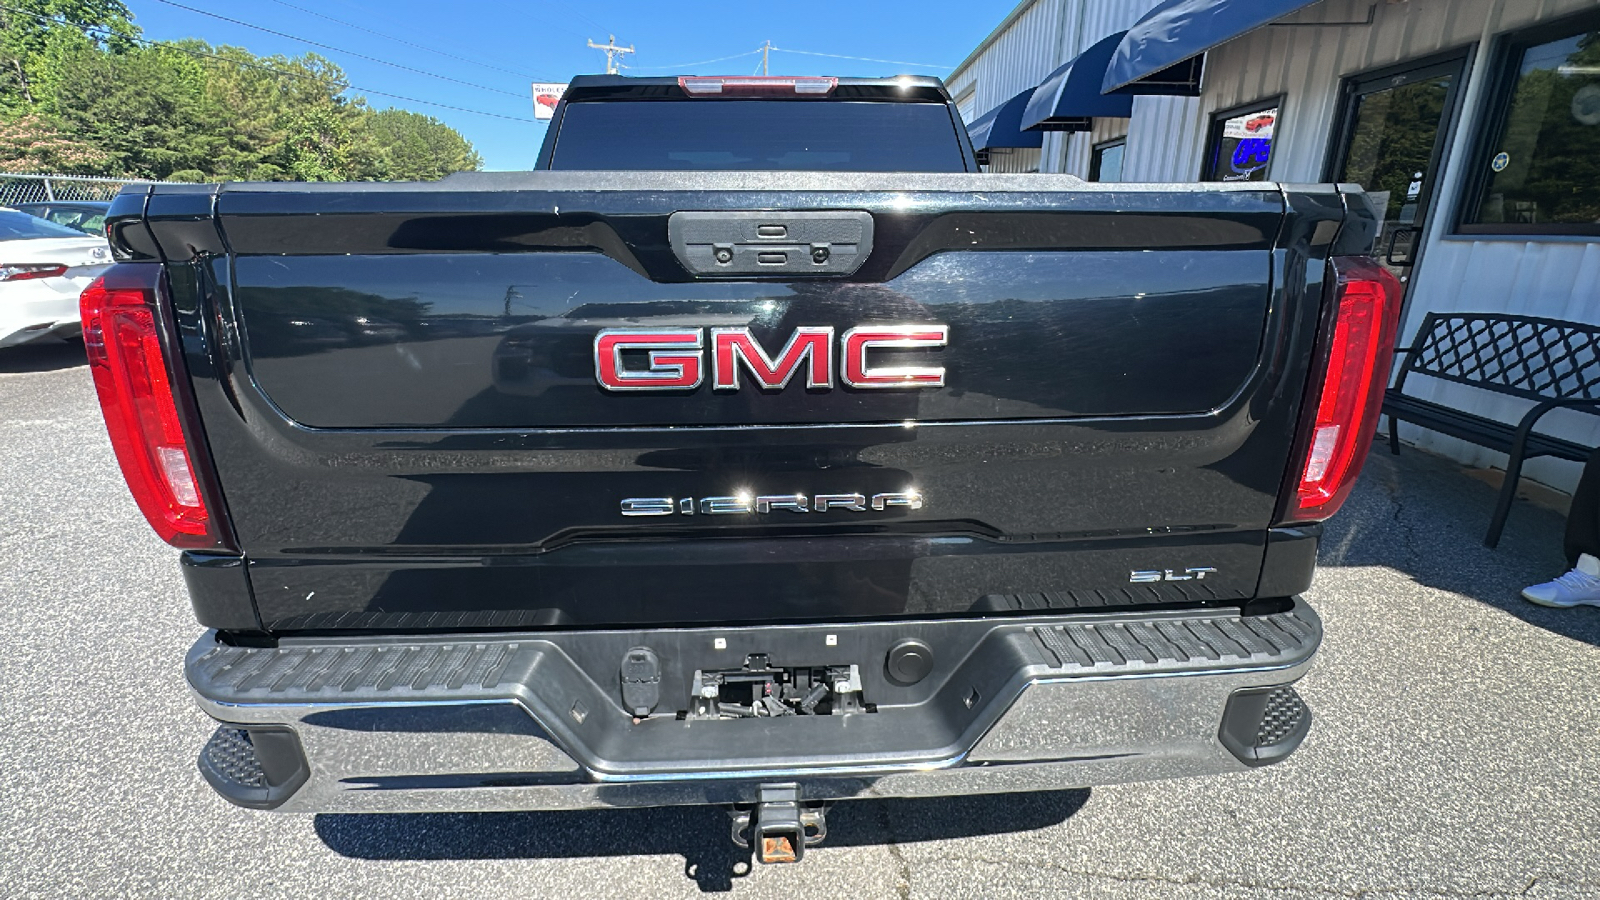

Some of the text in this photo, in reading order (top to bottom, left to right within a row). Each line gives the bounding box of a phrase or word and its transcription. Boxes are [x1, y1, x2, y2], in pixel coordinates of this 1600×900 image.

[593, 324, 949, 391] GMC
[620, 491, 923, 516] SIERRA
[1129, 567, 1218, 583] SLT
